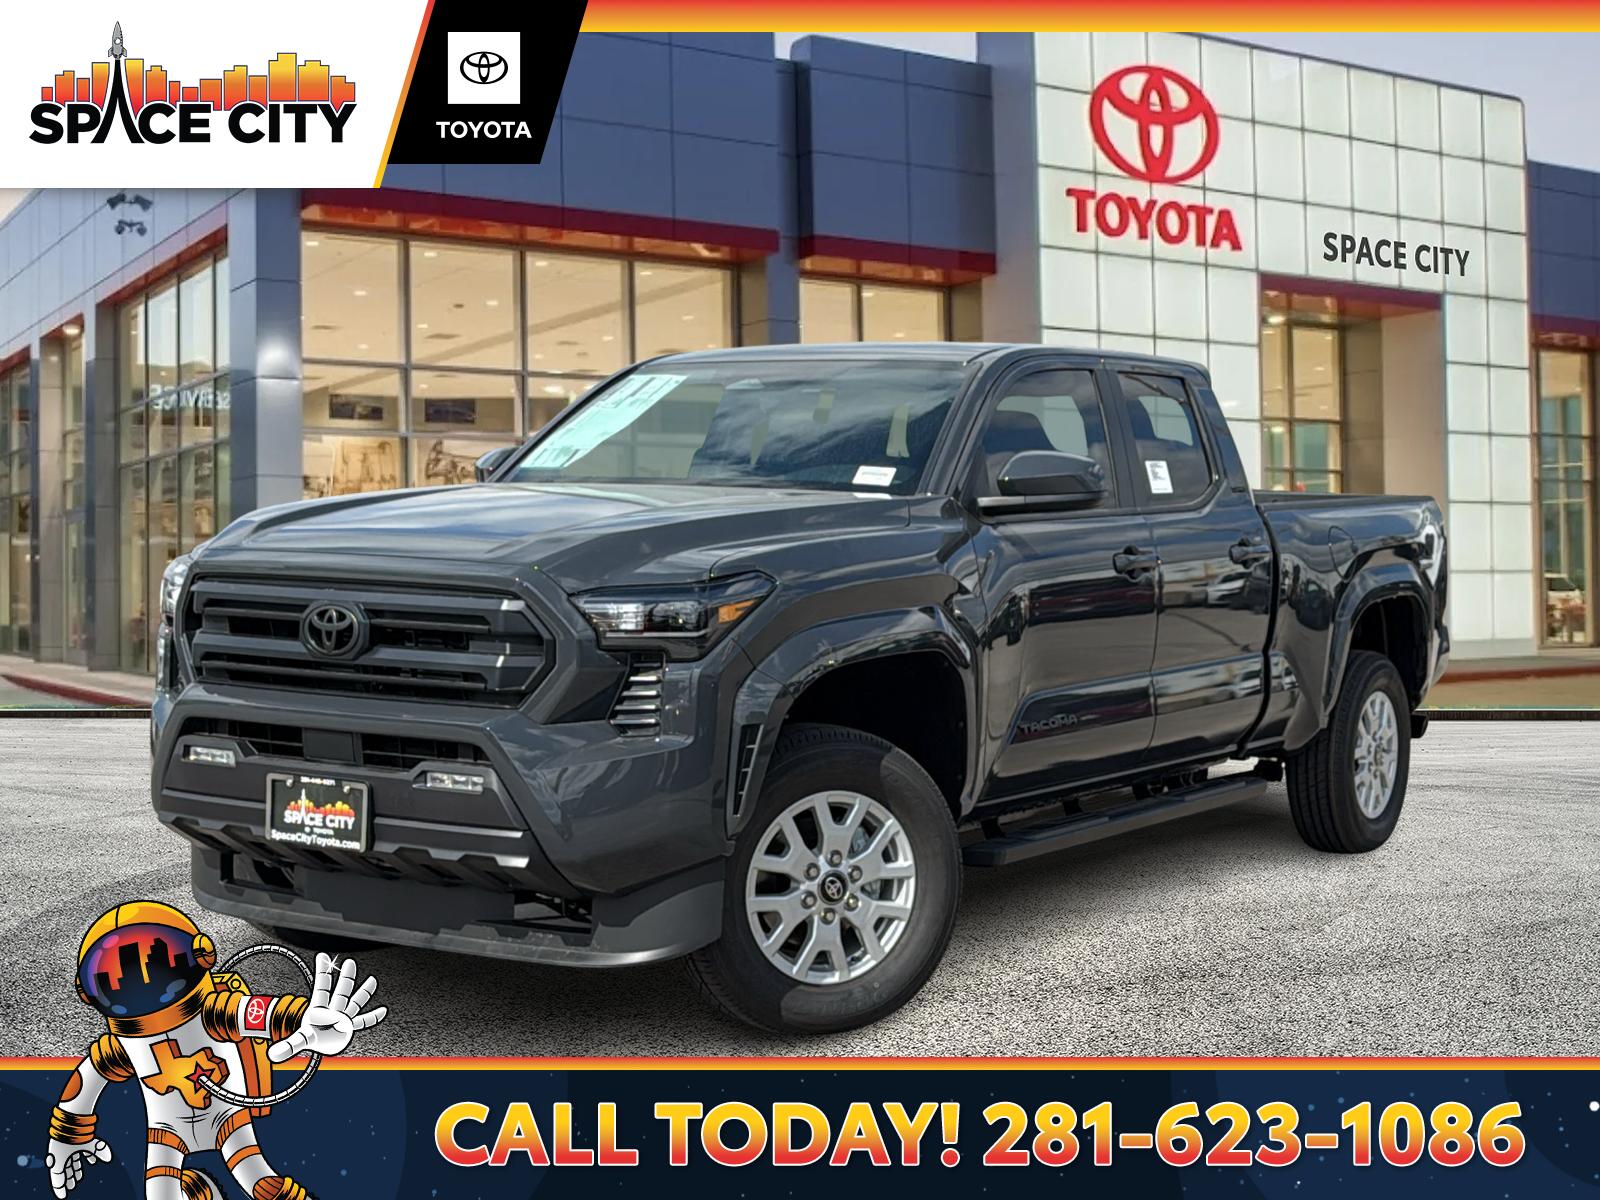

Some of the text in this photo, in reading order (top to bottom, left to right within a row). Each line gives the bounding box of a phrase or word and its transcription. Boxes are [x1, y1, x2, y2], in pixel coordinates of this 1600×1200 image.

[1065, 188, 1242, 251] TOYOTA
[1323, 232, 1470, 277] SPACE CITY
[1020, 713, 1078, 734] TACOMA
[283, 810, 355, 830] SPACE CITY
[271, 829, 360, 850] SpaceCityToyota.com
